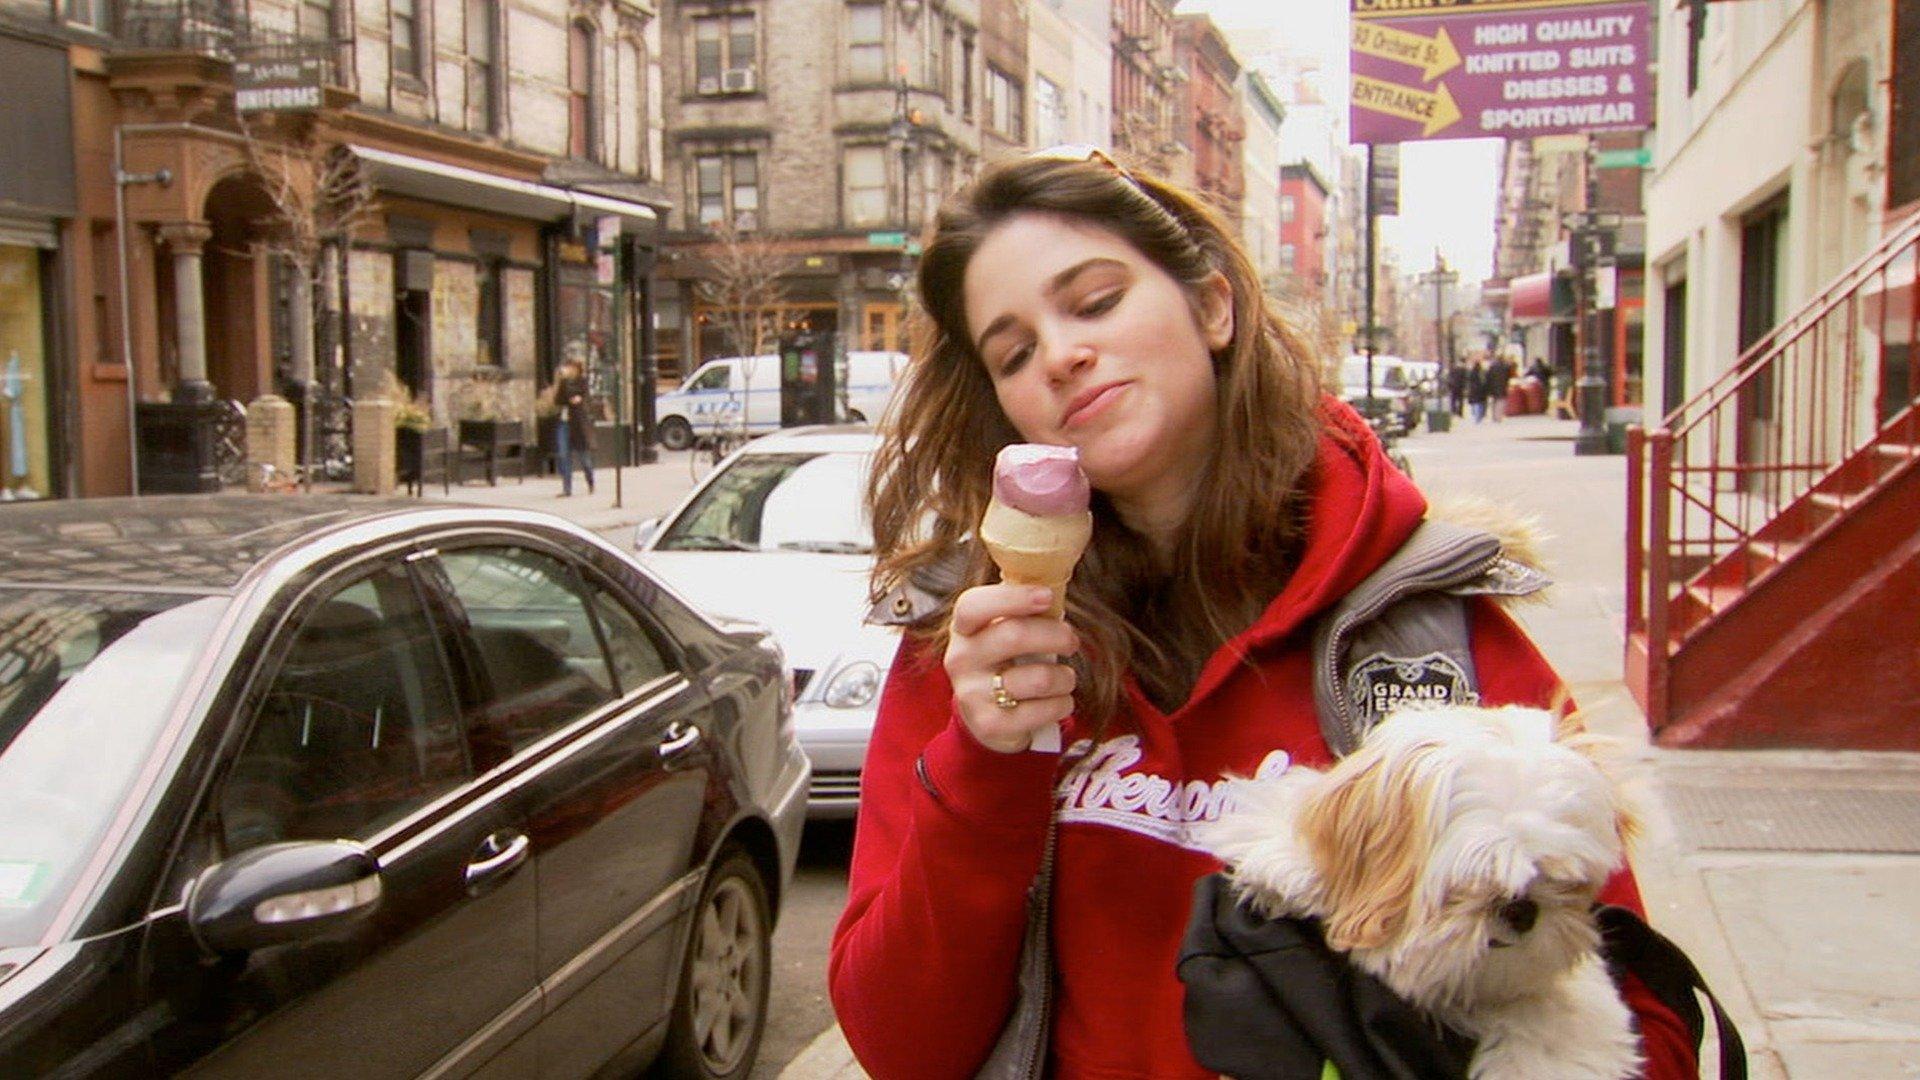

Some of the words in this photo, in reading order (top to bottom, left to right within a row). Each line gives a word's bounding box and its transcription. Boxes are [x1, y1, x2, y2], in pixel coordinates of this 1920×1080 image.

[1474, 23, 1528, 46] HIGH
[1535, 15, 1634, 42] QUALITY
[1465, 50, 1561, 74] KNITTED
[1568, 44, 1636, 69] SUITS
[236, 86, 319, 110] UNIFORMS
[1352, 80, 1438, 119] ENTRANCE
[1503, 74, 1608, 100] DRESSES
[1616, 73, 1634, 94] &
[1480, 102, 1635, 130] SPORTSWEAR
[1373, 683, 1449, 699] GRAND
